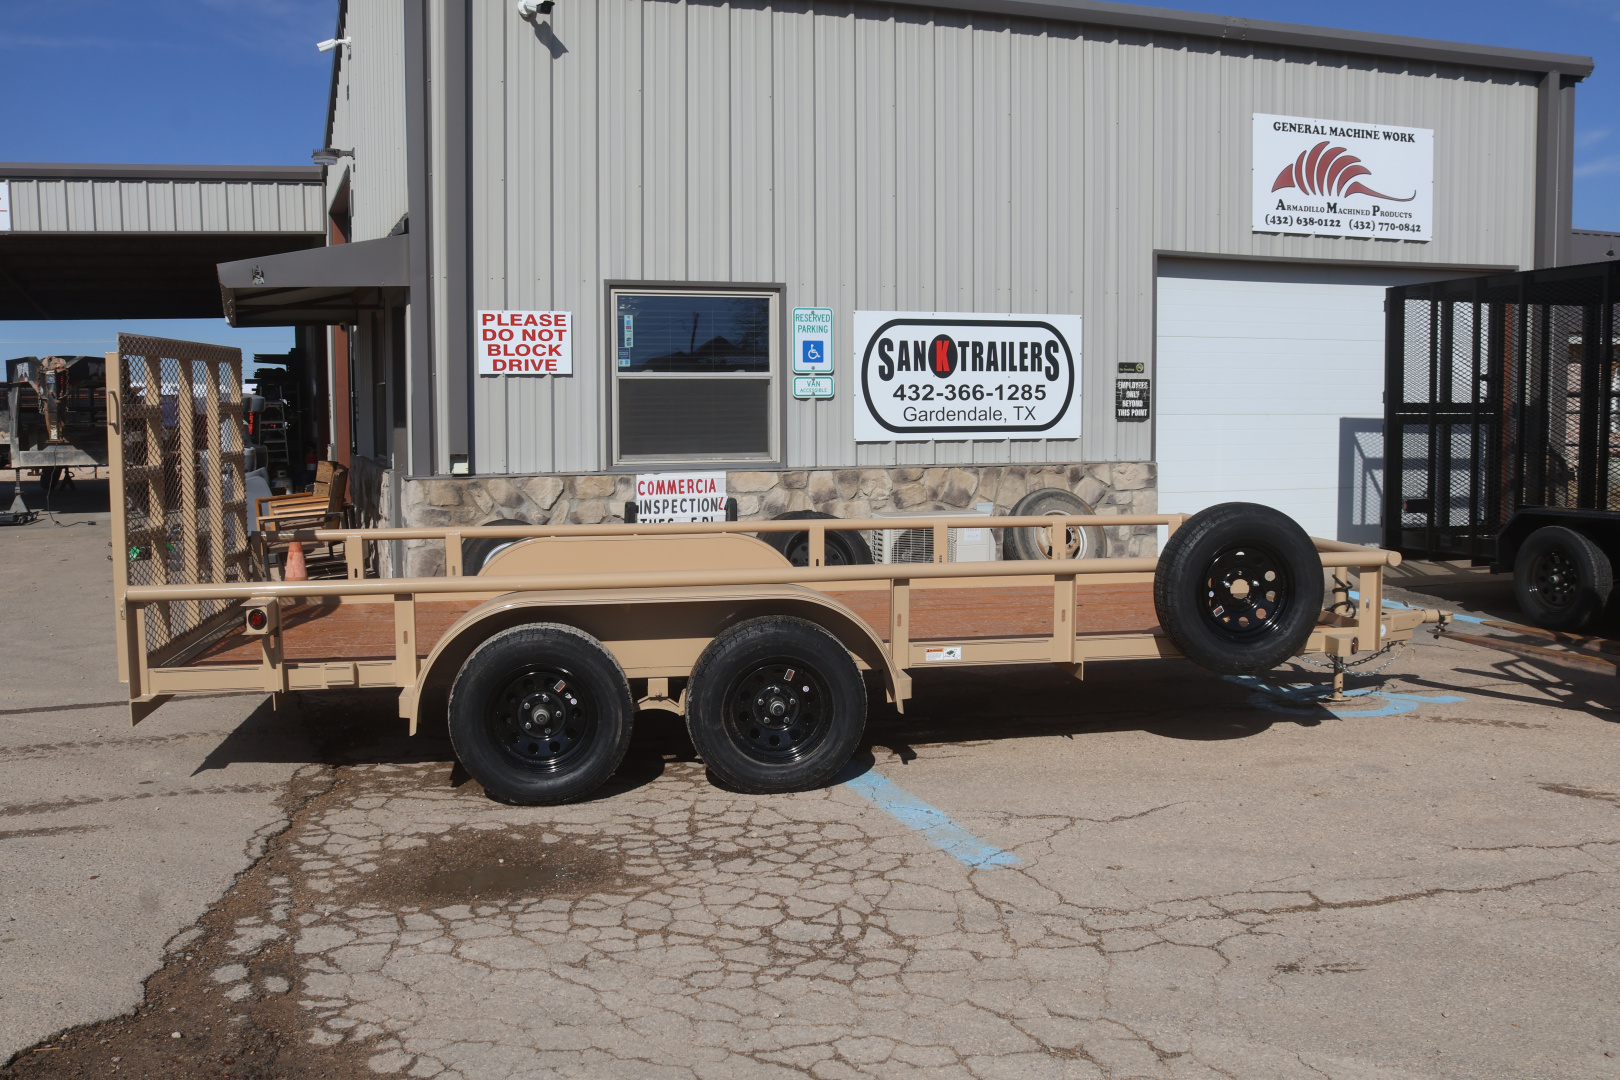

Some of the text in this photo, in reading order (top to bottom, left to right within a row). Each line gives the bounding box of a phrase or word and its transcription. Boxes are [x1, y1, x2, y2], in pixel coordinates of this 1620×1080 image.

[1273, 121, 1416, 143] GENERAL MACHINE WORK
[1275, 198, 1413, 218] ARMADILLO MACHINED PRODUCTS
[1265, 214, 1421, 233] (432) 638-0122 (432) 770-0842
[482, 313, 567, 326] PLEASE
[795, 314, 830, 322] RESERVED
[482, 328, 567, 341] DO NOT
[797, 325, 828, 333] PARKING
[487, 343, 563, 356] BLOCK
[492, 358, 558, 372] DRIVE
[1118, 381, 1148, 389] EMPLOYEES
[892, 383, 1047, 402] 432-366-1285
[902, 406, 1037, 423] Gardendale, TX
[637, 478, 717, 496] COMMERCIA
